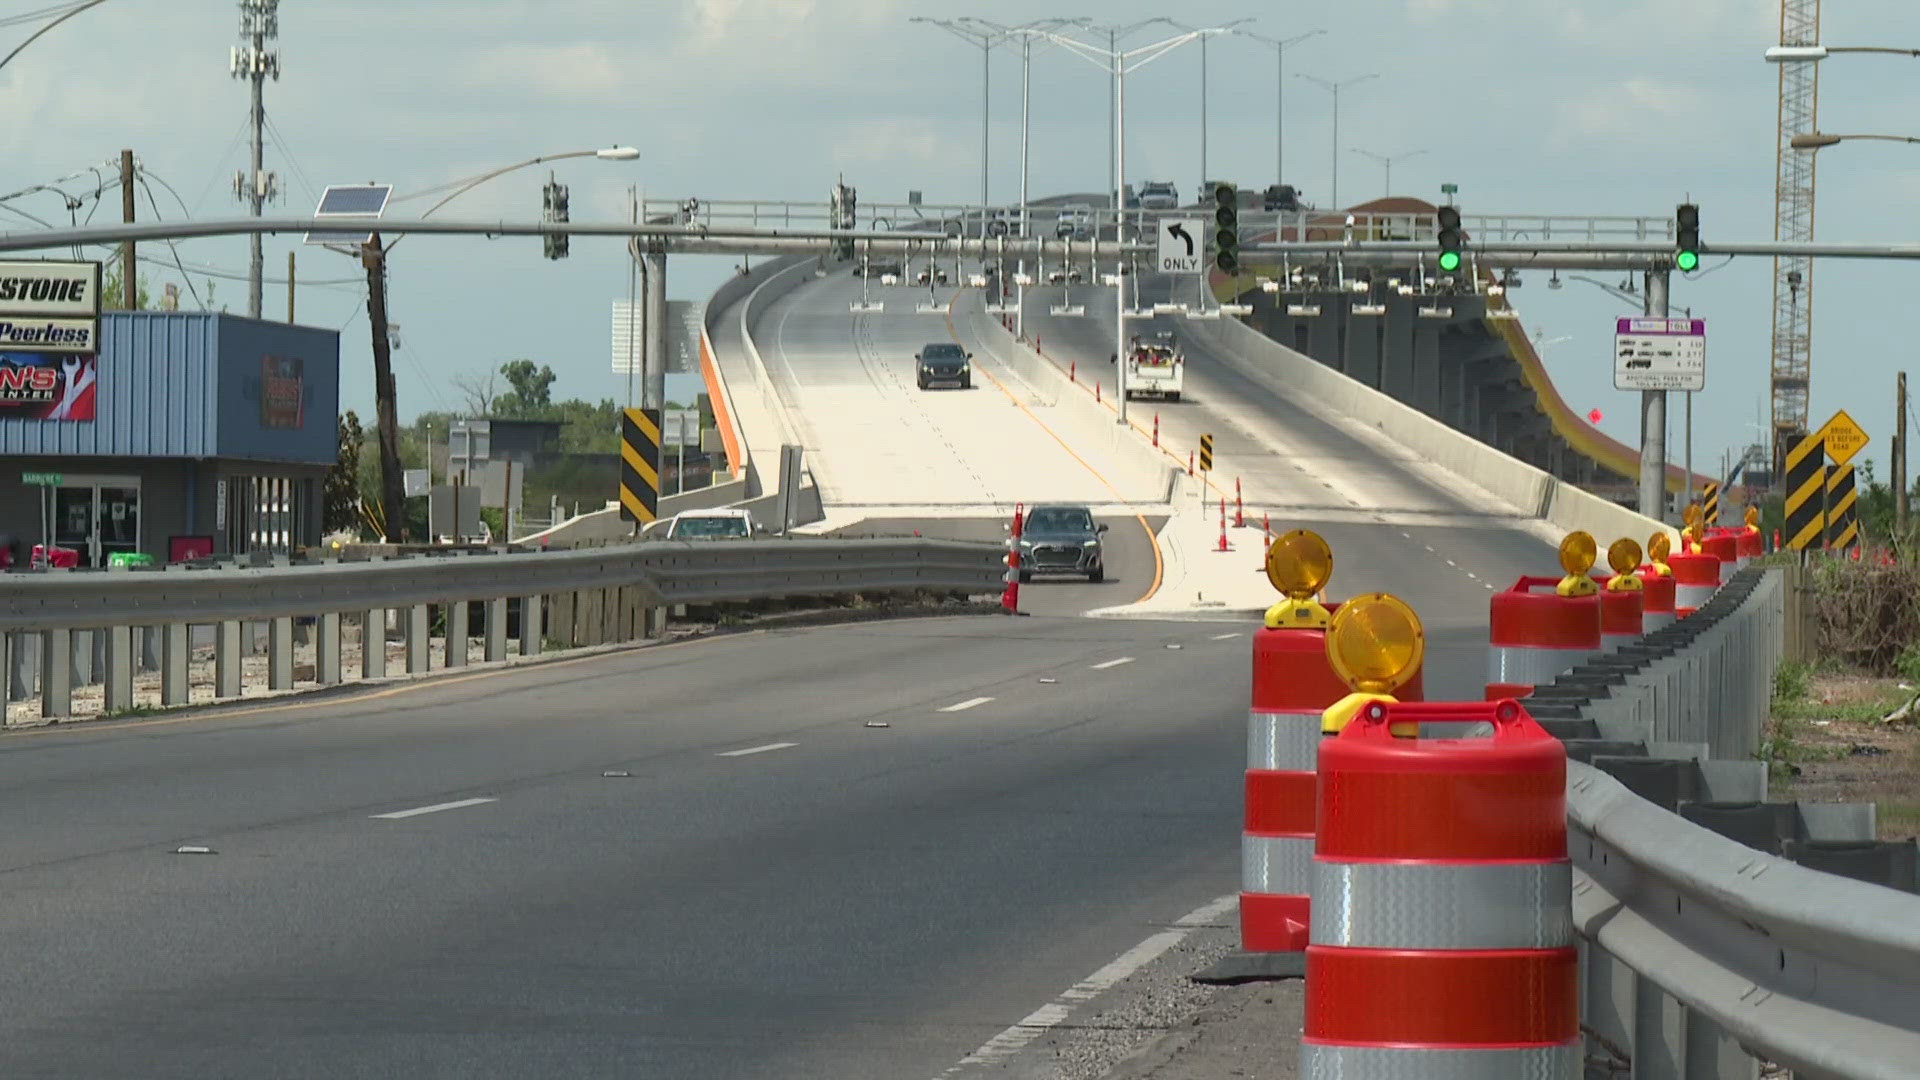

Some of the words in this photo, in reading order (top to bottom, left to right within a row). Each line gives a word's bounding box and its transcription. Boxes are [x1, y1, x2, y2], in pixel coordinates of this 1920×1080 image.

[1163, 257, 1198, 270] ONLY
[0, 277, 87, 302] STONE
[0, 322, 89, 342] Peerless
